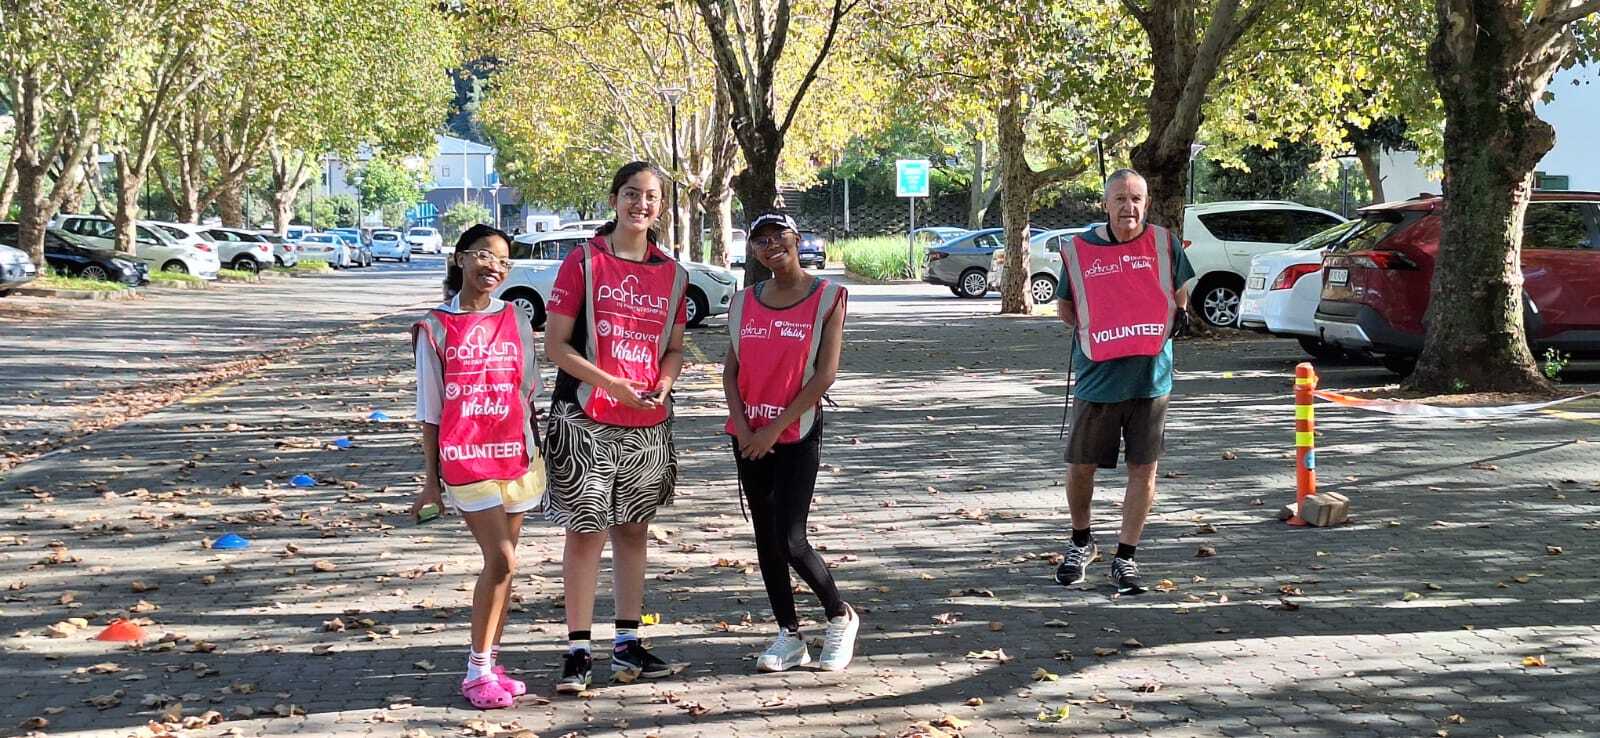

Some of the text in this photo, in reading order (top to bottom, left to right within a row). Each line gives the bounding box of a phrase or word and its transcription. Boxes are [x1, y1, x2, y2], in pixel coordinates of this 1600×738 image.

[598, 281, 669, 311] parkrun
[1092, 323, 1164, 343] VOLUNTEER
[446, 338, 518, 362] parkrun
[611, 339, 653, 369] Vitality
[461, 397, 510, 421] Vitality
[440, 441, 523, 462] VOLUNTEER
